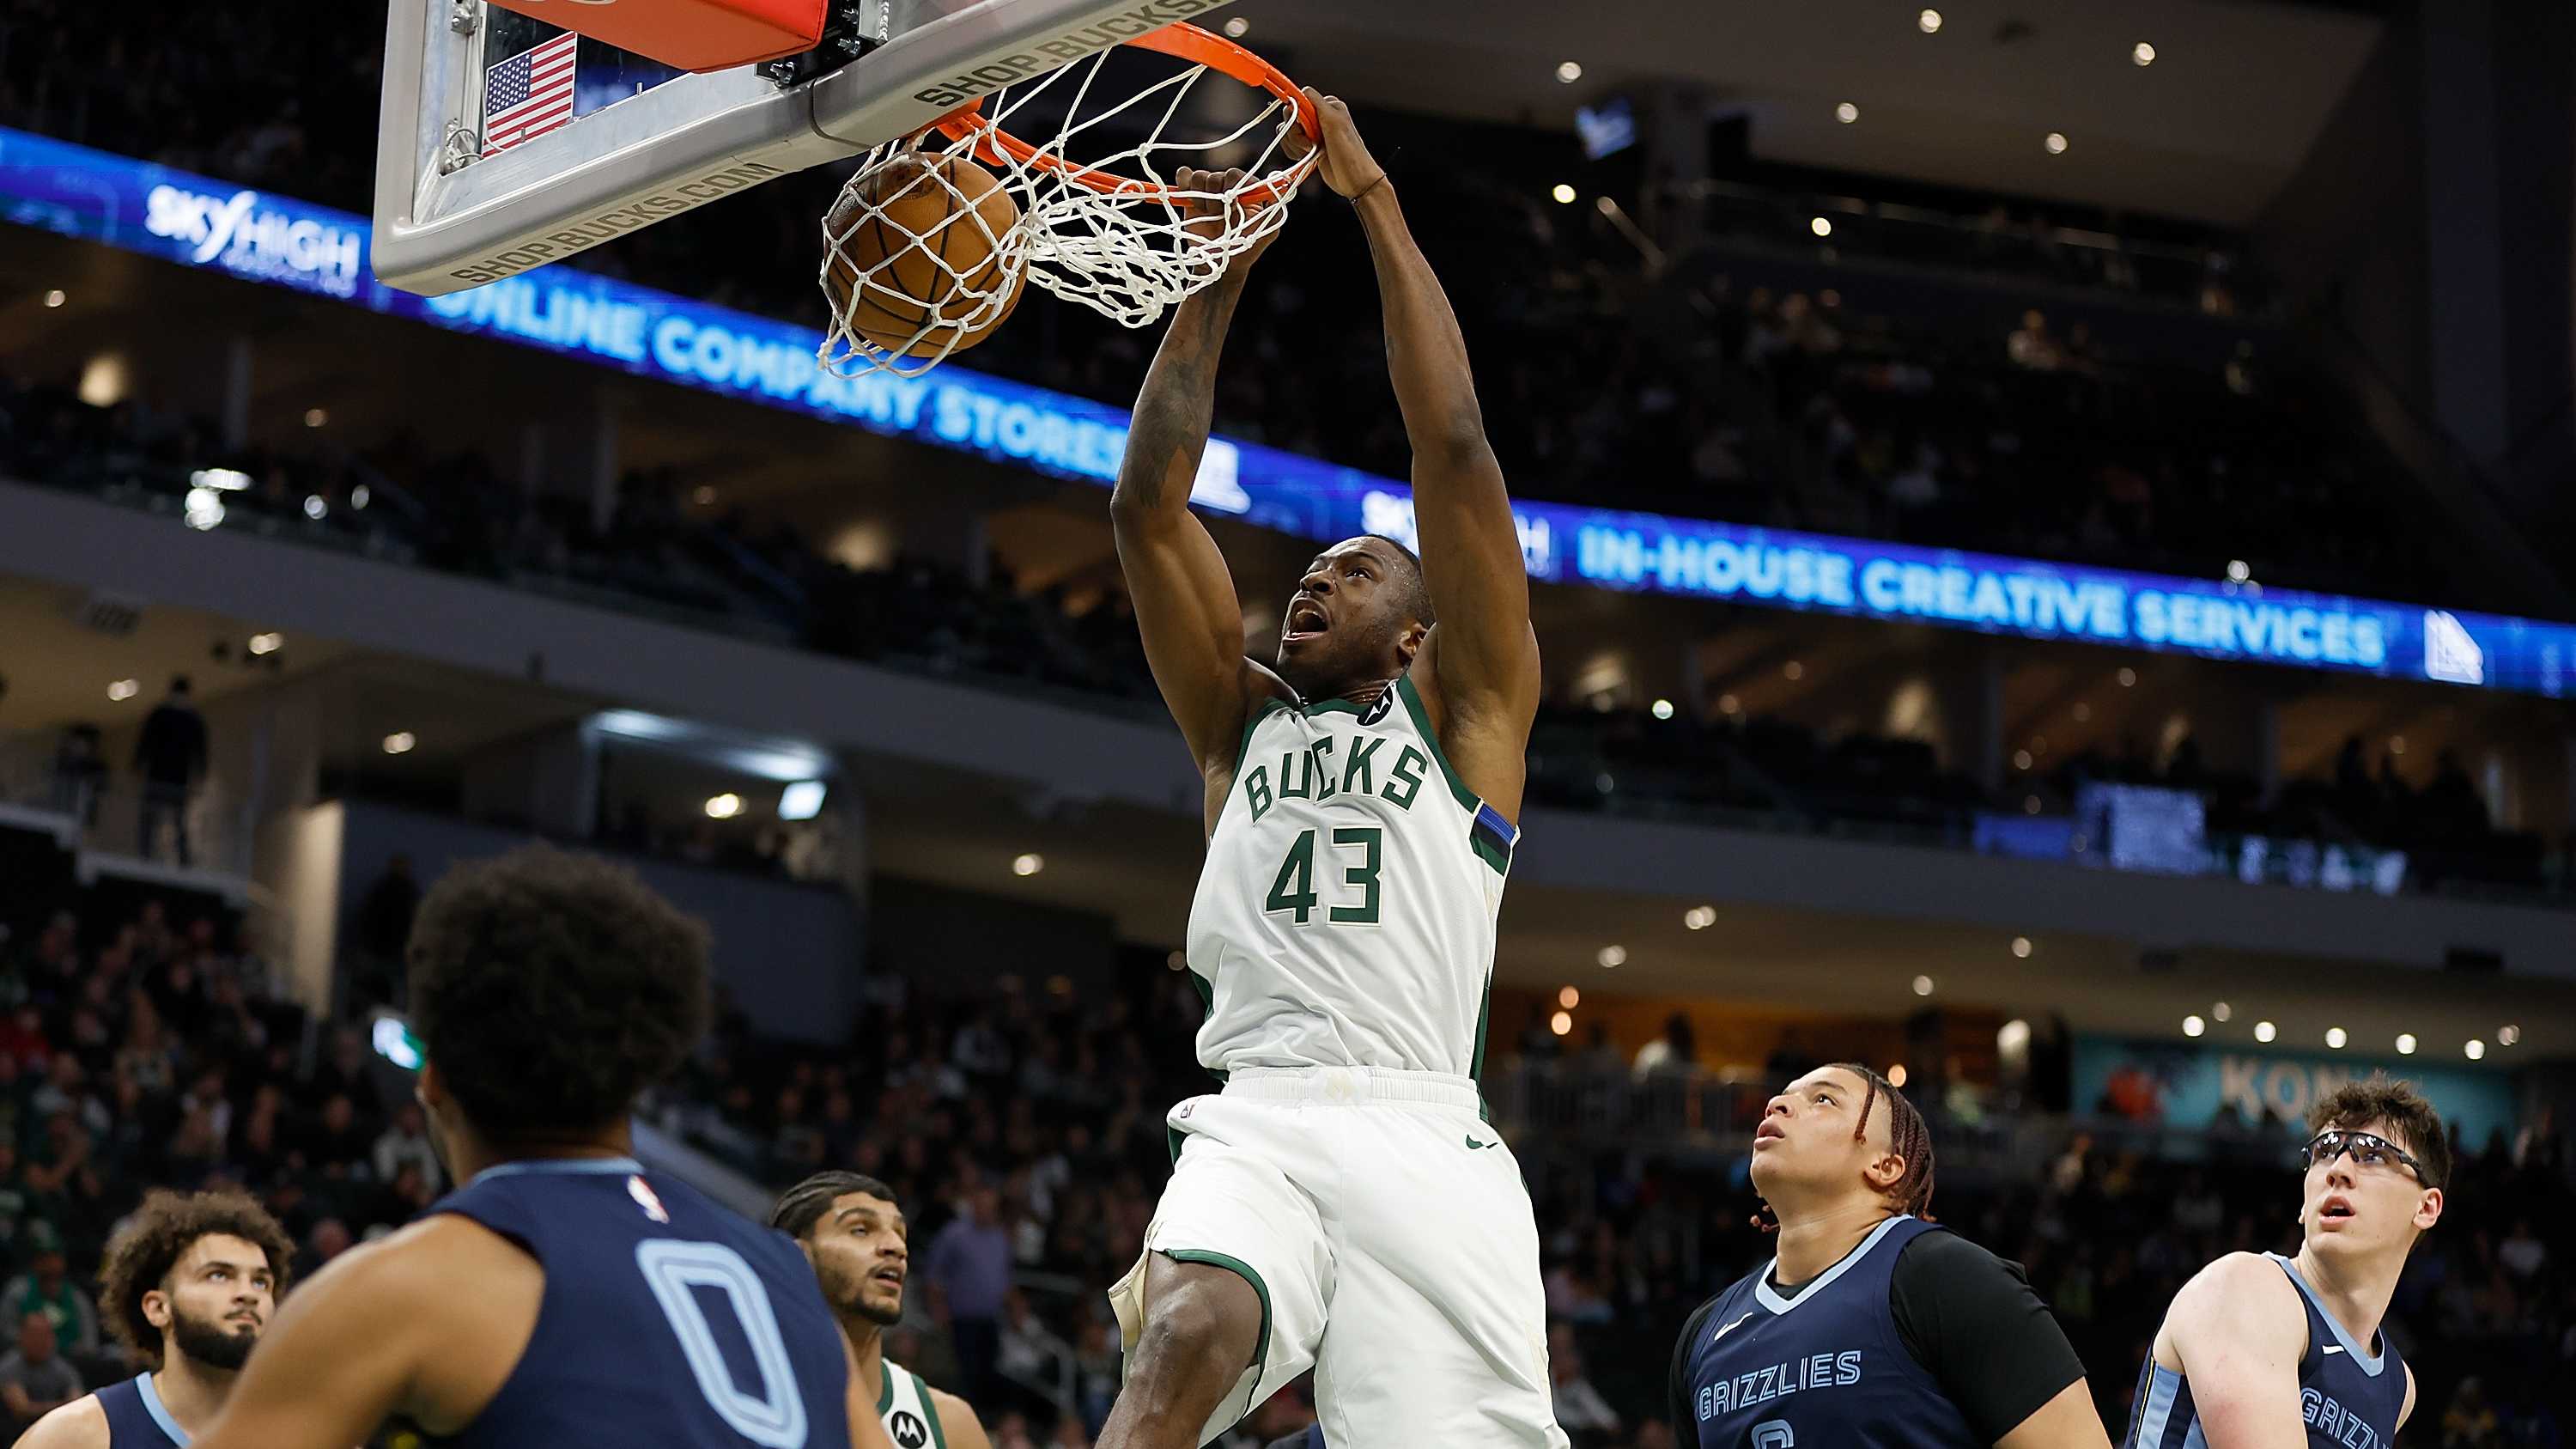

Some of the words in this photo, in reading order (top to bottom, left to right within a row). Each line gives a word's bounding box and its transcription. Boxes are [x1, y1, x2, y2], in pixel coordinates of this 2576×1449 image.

[449, 161, 785, 283] SHOP.BUCKS.COM
[655, 314, 929, 429] COMPANY
[1577, 523, 1856, 609] IN-HOUSE
[1860, 557, 2128, 639] CREATIVE
[2134, 588, 2386, 668] SERVICES
[1244, 734, 1430, 827] BUCKS
[1263, 826, 1385, 928] 43
[635, 1238, 808, 1449] 0
[1698, 1349, 1862, 1422] GRIZZLIES
